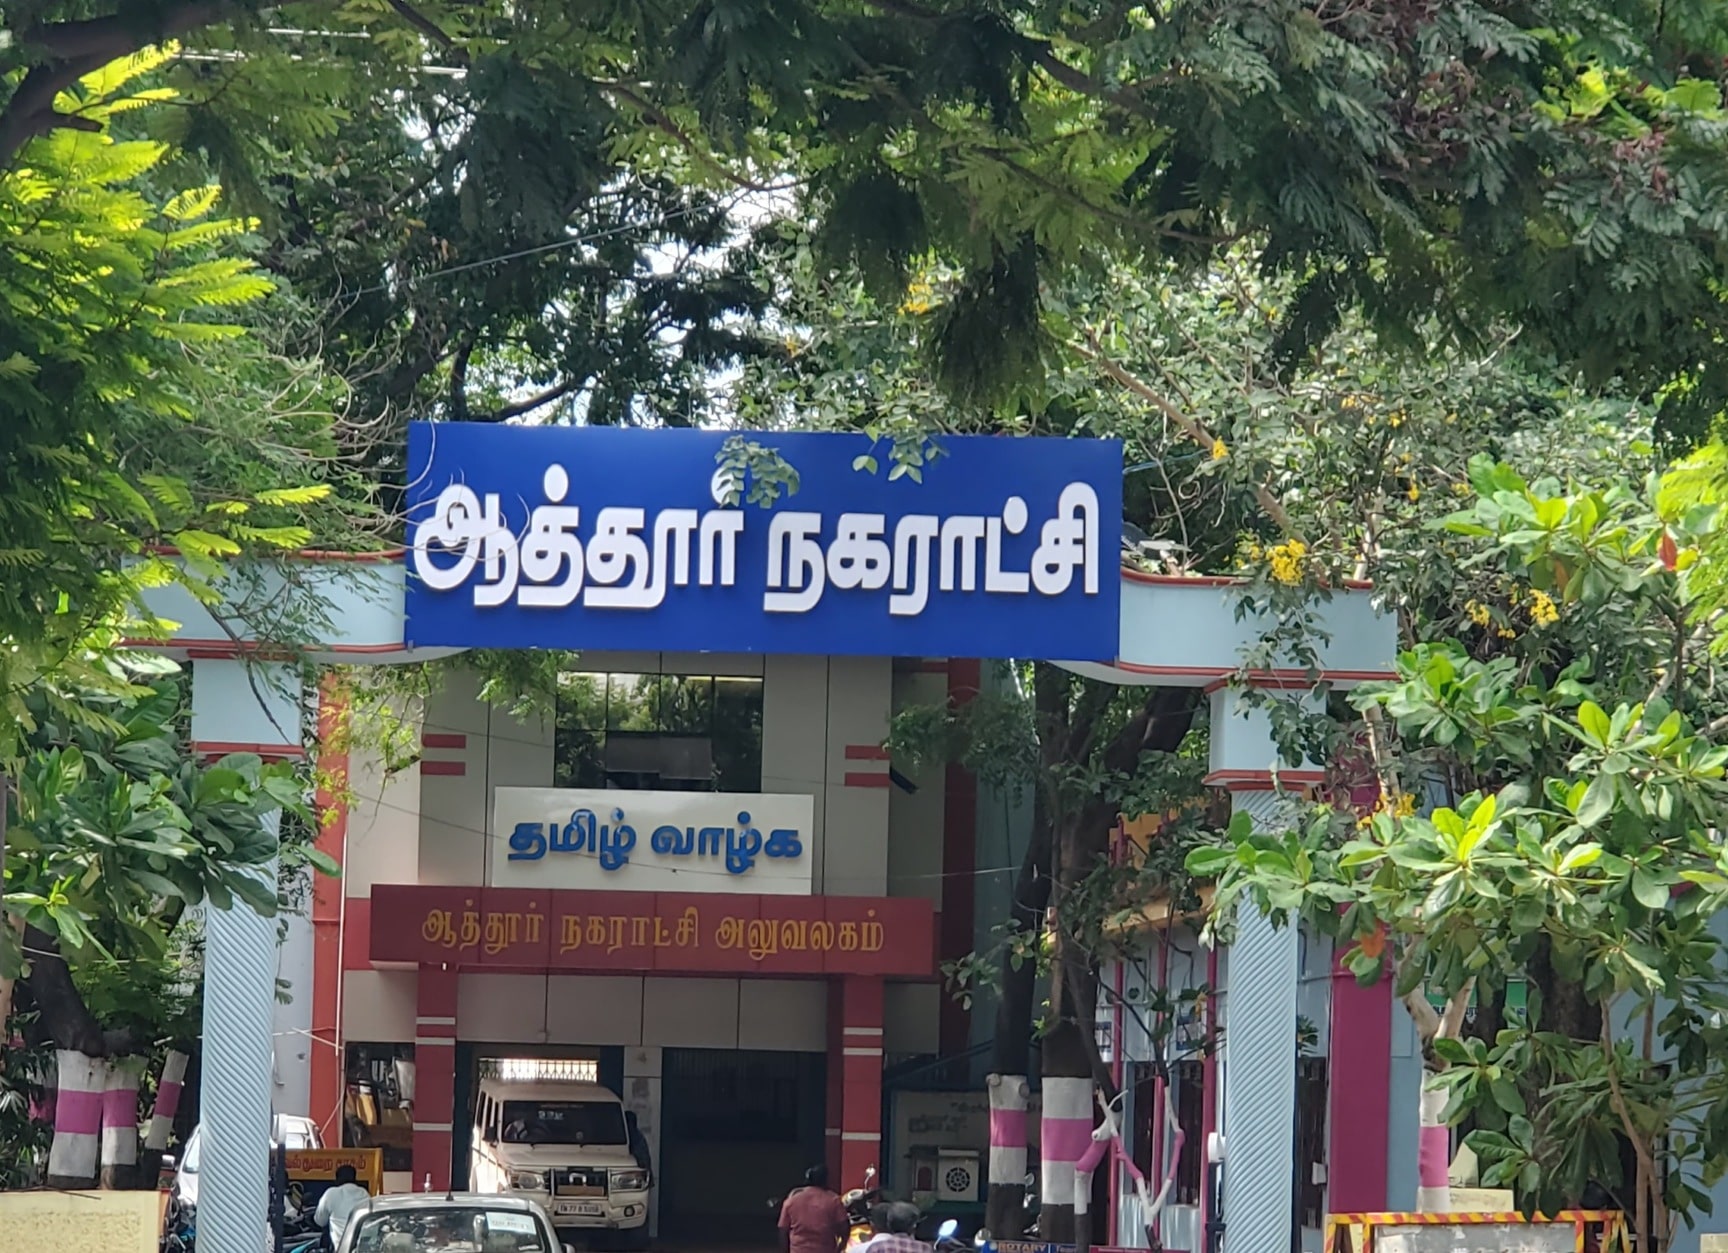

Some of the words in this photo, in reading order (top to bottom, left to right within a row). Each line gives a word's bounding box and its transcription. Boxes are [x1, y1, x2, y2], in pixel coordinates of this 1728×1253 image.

[412, 463, 746, 611] ஆத்தூர்
[763, 481, 1100, 616] நகராட்சி
[507, 807, 637, 872] தமிழ்
[650, 810, 803, 875] வாழ்க
[421, 899, 545, 953] ஆத்தூர்
[558, 906, 701, 955] நகராட்சி
[714, 909, 886, 961] அலுவலகம்
